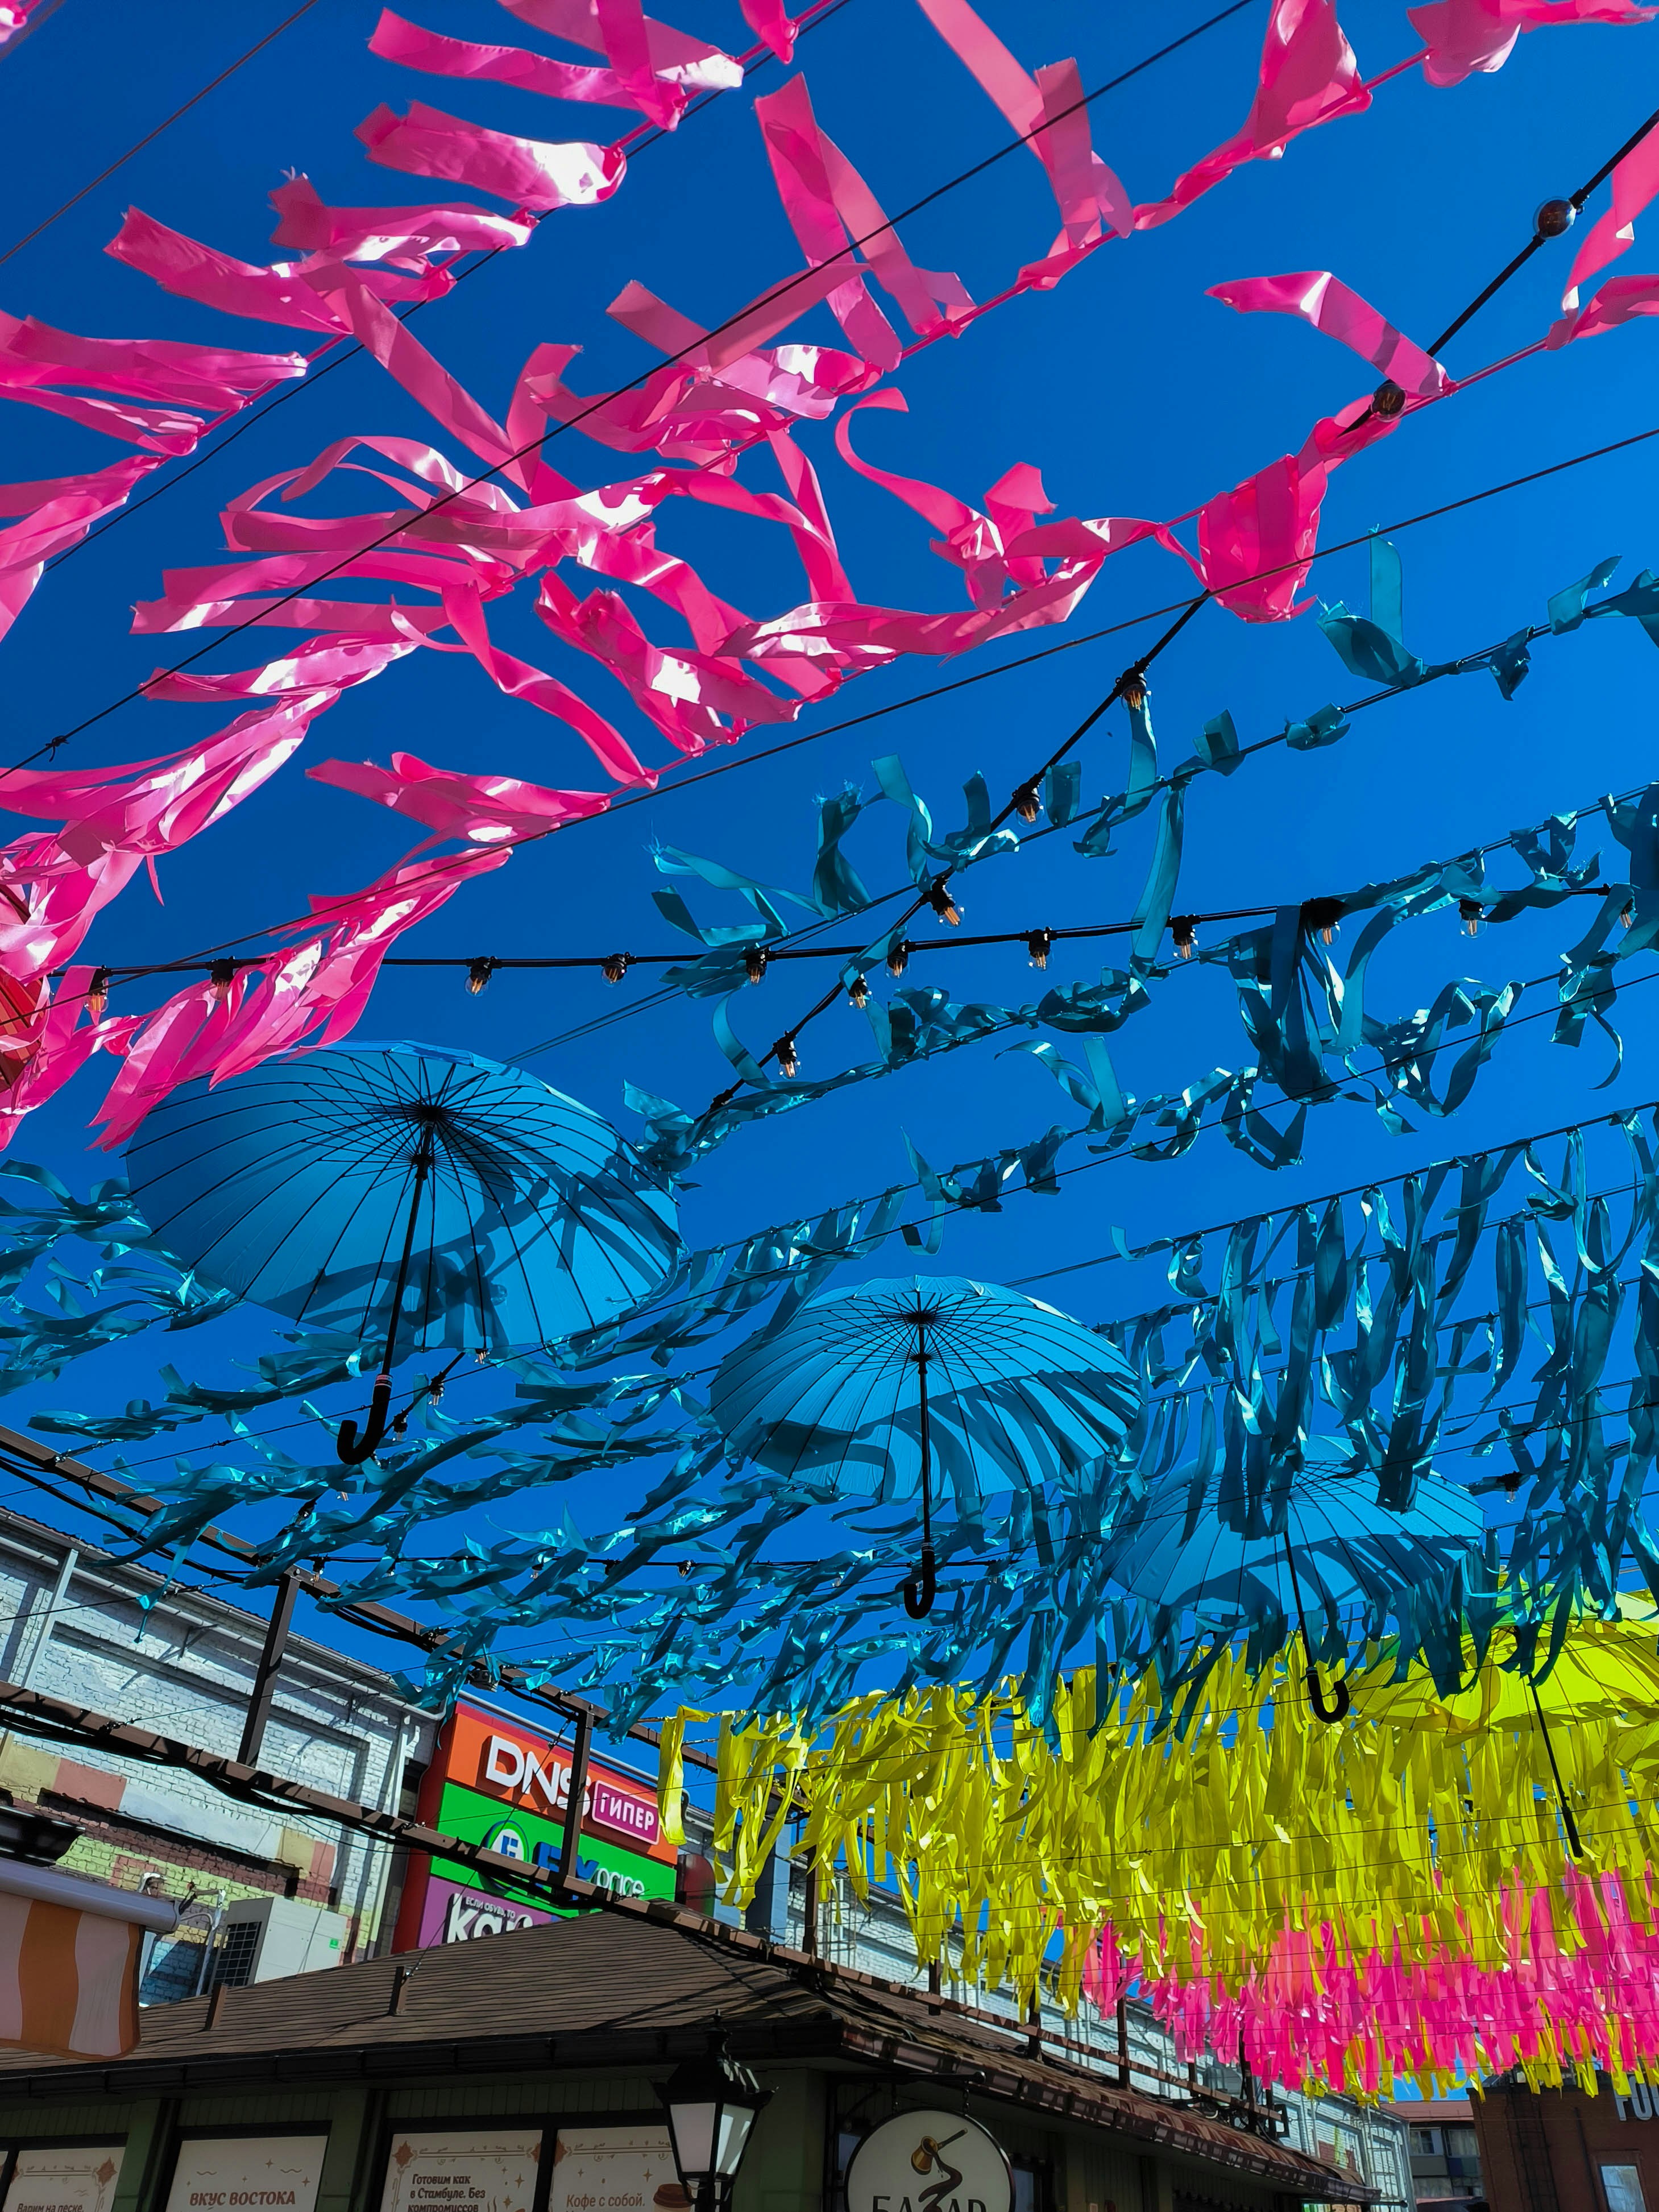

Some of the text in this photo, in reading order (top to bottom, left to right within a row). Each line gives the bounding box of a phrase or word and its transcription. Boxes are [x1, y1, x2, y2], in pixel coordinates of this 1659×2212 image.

[486, 1735, 591, 1816] DNS
[600, 1792, 654, 1830] ГИПЕР
[466, 1896, 483, 1909] ЕСЛИ
[507, 1909, 516, 1918] ТО
[412, 2174, 471, 2184] Готовим как
[190, 2191, 296, 2206] ВКУС ВОСТОКА
[468, 2188, 486, 2198] Без
[566, 2193, 645, 2210] Кофе с собой.
